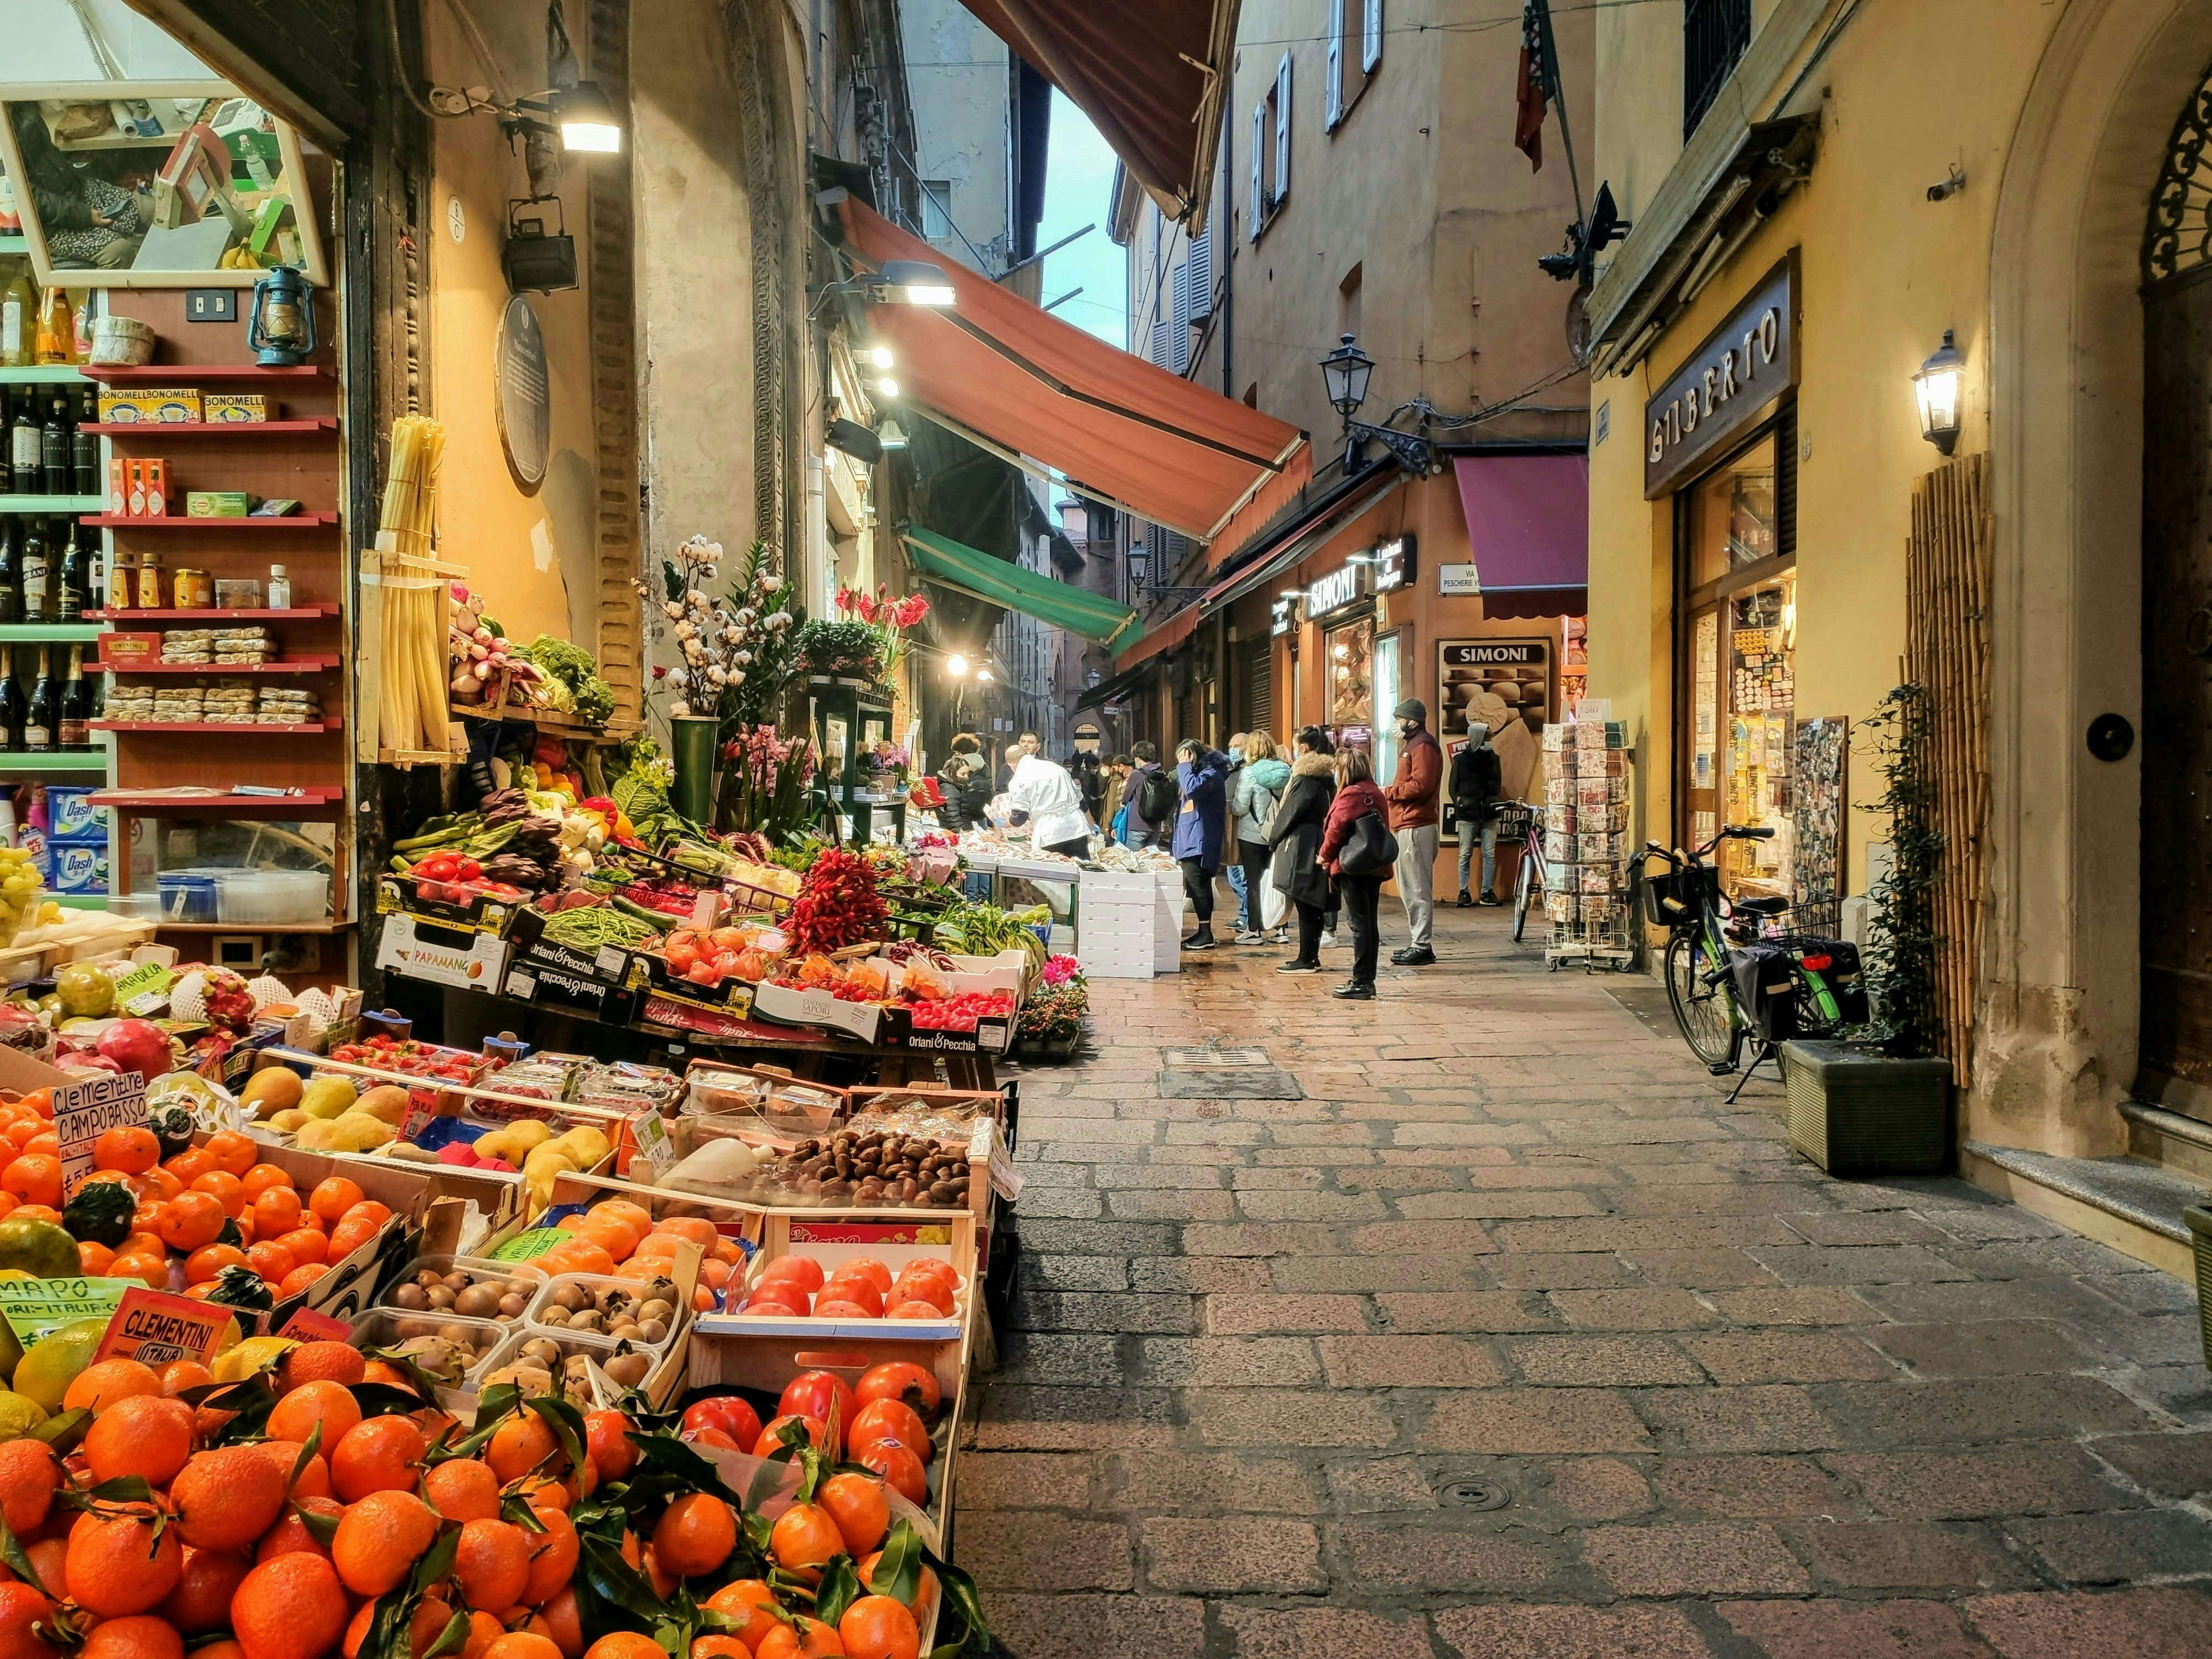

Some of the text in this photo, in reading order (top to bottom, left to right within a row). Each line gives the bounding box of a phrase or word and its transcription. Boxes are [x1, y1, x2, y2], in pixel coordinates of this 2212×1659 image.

[147, 390, 199, 399] BONOMELLI
[1650, 309, 1776, 463] GILBERTO
[98, 391, 147, 399] BONOMELL
[205, 397, 264, 406] BONOMELLI
[1311, 564, 1357, 615] SIMONI
[1460, 648, 1527, 662] SIMONI
[67, 801, 92, 817] Dash
[26, 837, 40, 848] WC
[67, 853, 92, 870] Dash
[555, 947, 567, 963] &
[562, 956, 594, 975] Pecchia
[116, 963, 163, 992] ANADILLA
[539, 971, 572, 989] Pecchia
[570, 979, 581, 996] &
[581, 981, 606, 997] Oriani
[802, 1005, 830, 1016] SAPORI
[909, 1032, 976, 1051] Oriani & Pecchia
[54, 1074, 143, 1113] Clementine
[60, 1097, 146, 1142] CAMPOBASSO
[508, 1229, 544, 1259] VANIGLIA
[0, 1279, 88, 1298] MAPO
[124, 1309, 214, 1350] CLEMENTINI
[142, 1347, 179, 1362] ITALIA
